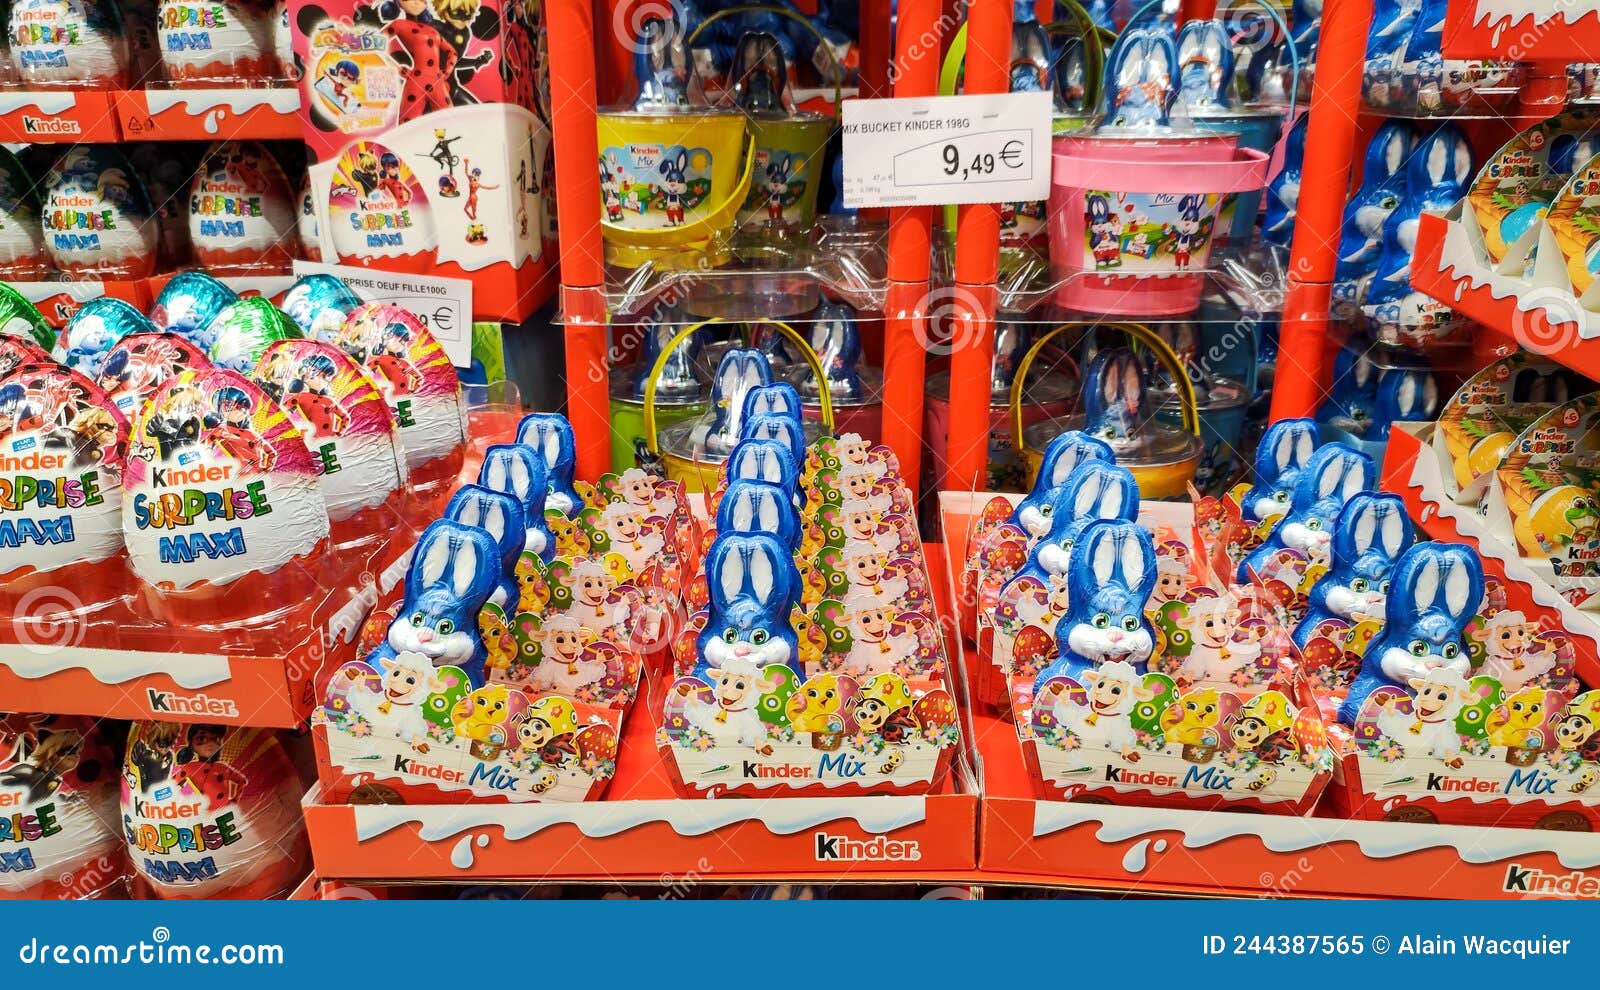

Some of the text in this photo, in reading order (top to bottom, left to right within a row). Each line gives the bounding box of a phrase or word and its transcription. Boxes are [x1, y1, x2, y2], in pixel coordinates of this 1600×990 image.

[16, 8, 58, 21] Kinder
[166, 31, 212, 52] MAXI
[25, 116, 80, 134] Kinder
[861, 121, 902, 133] BUCKET
[905, 119, 943, 131] KINDER
[945, 118, 970, 129] 198G
[1503, 156, 1532, 164] Kinder
[201, 180, 243, 193] Kinder
[51, 194, 95, 207] Kinder
[200, 219, 246, 238] MAXI
[54, 233, 101, 251] MAXI
[366, 232, 404, 248] MAXI
[341, 278, 375, 289] RPRISE
[377, 281, 400, 292] OEUF
[1535, 431, 1564, 441] Kinder
[0, 452, 67, 472] inder
[153, 464, 233, 489] Kinder
[0, 471, 104, 513] RPRISE
[133, 480, 272, 530] SURPRISE
[159, 527, 247, 563] MAXI
[1568, 546, 1600, 560] Kind
[148, 688, 238, 717] Kinder
[394, 754, 520, 791] Kinder Mix
[743, 752, 867, 779] Kinder Mix
[1105, 764, 1235, 790] Kinder Mix
[1426, 768, 1558, 794] Kinder Mix
[134, 796, 202, 819] Kinder
[124, 811, 243, 855] SURPRISE
[816, 833, 921, 862] Kinder
[143, 856, 219, 882] MAXI
[1505, 865, 1600, 897] Kinde
